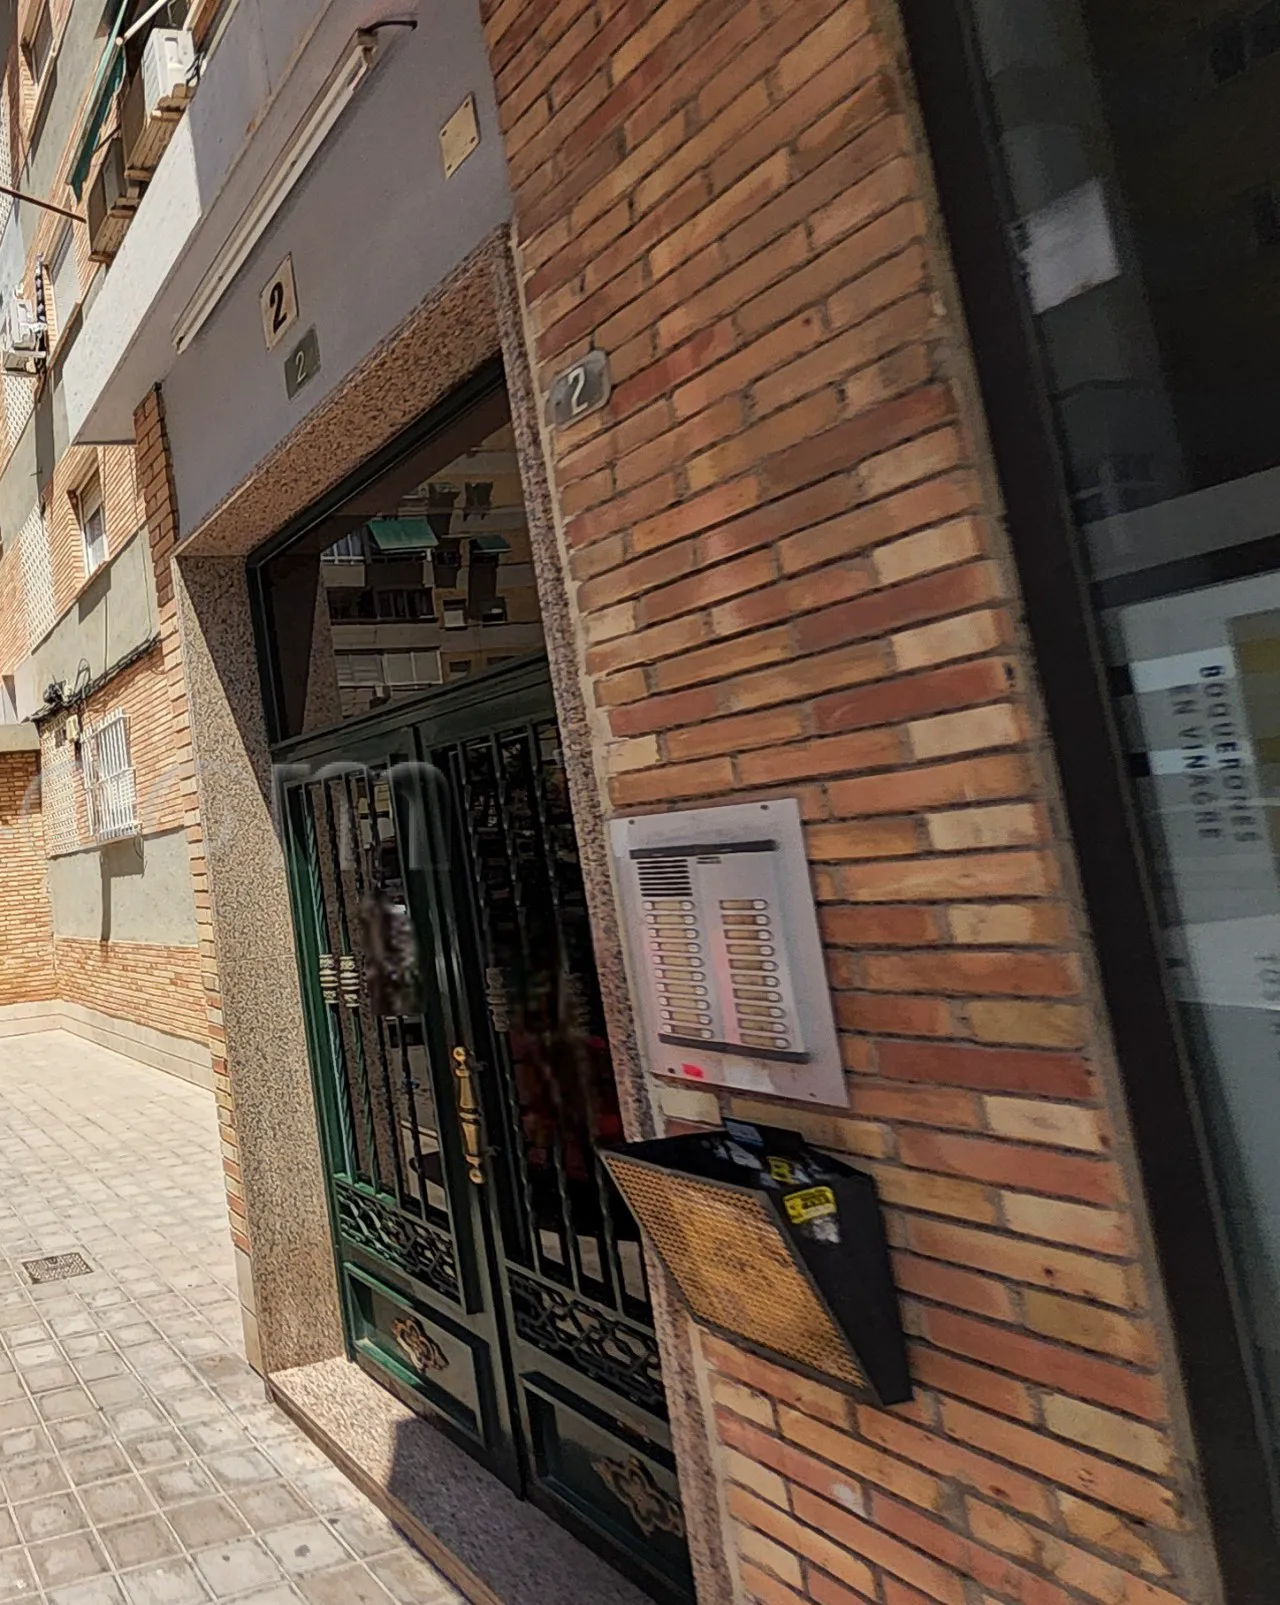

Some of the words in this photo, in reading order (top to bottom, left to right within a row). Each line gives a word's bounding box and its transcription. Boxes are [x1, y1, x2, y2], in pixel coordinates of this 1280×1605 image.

[269, 281, 288, 334] 2
[296, 350, 307, 384] 2
[567, 366, 589, 416] 2
